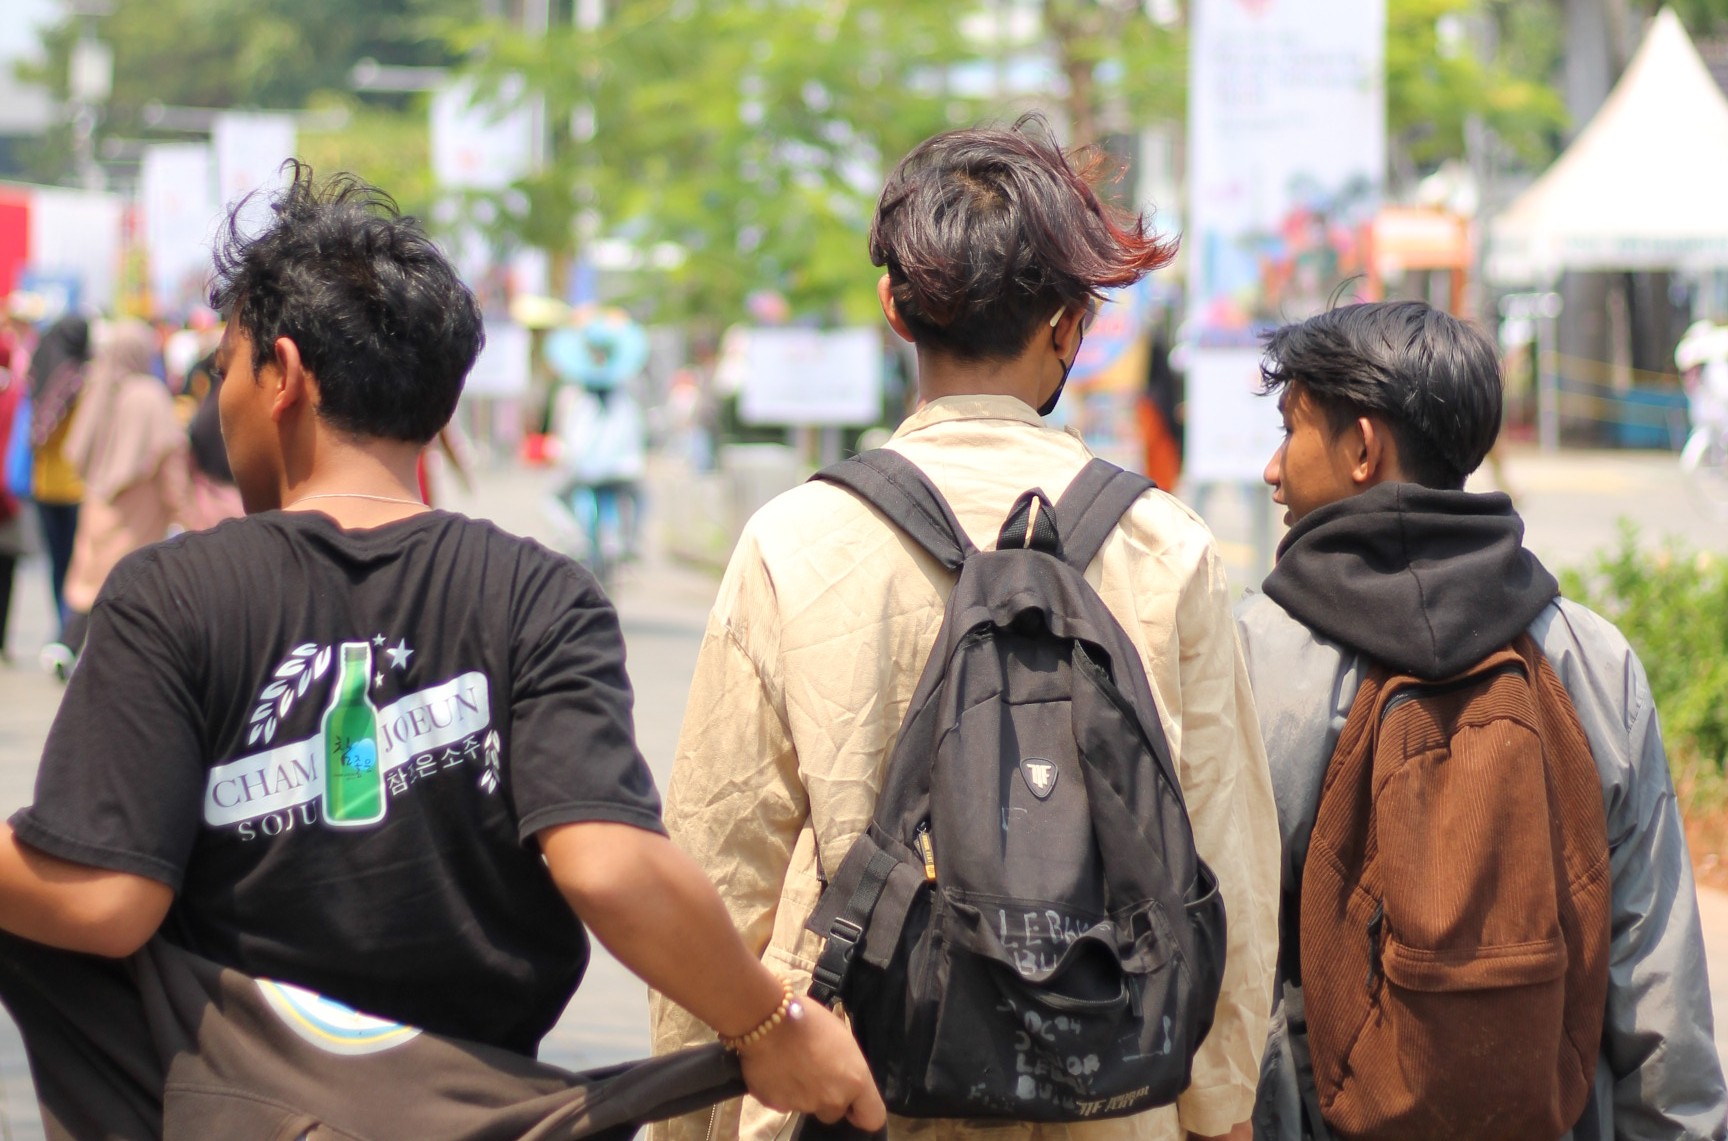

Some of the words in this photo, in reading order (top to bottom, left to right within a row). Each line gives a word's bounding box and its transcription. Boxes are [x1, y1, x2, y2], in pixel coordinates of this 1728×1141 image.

[380, 687, 479, 752] JOEUN
[212, 752, 318, 808] CHAM
[238, 800, 318, 841] SOJU
